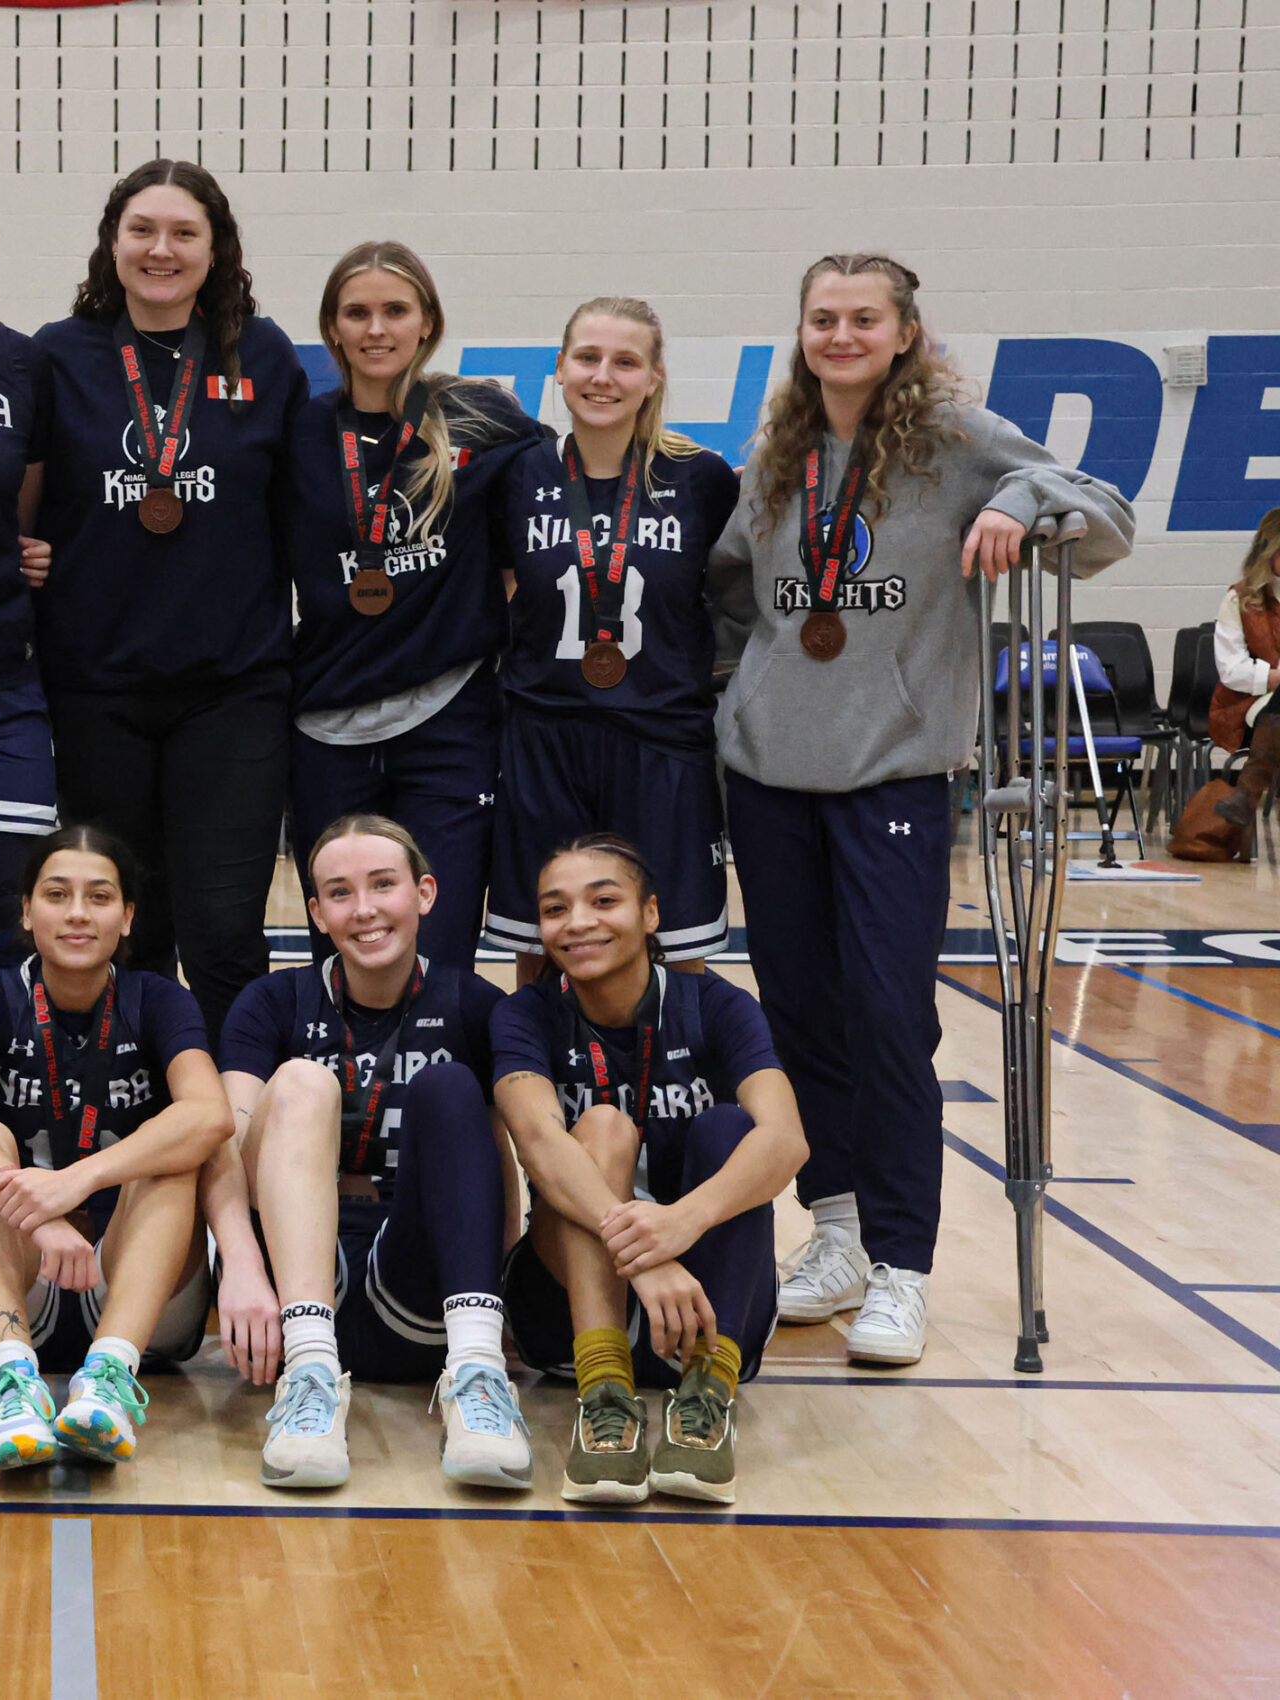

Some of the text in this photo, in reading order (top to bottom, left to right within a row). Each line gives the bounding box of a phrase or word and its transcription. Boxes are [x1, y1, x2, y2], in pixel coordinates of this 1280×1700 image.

[120, 344, 141, 382] OCAA
[132, 382, 150, 430] BASKETBALL
[168, 388, 188, 434] BASKETBALL
[158, 436, 179, 477] OCAA
[342, 430, 360, 470] OCAA
[350, 472, 364, 524] BASKETBALL
[616, 490, 634, 540] BASKETBALL
[369, 503, 389, 545] OCAA
[576, 528, 595, 569] OCAA
[606, 542, 628, 584] OCAA
[818, 558, 841, 602] OCAA
[830, 498, 852, 554] BASKETBALL
[32, 982, 52, 1025] OCAA
[42, 1028, 58, 1086] BASKETBALL
[415, 1018, 444, 1028] OCAA
[588, 1040, 610, 1088] OCAA
[77, 1103, 100, 1149] OCAA
